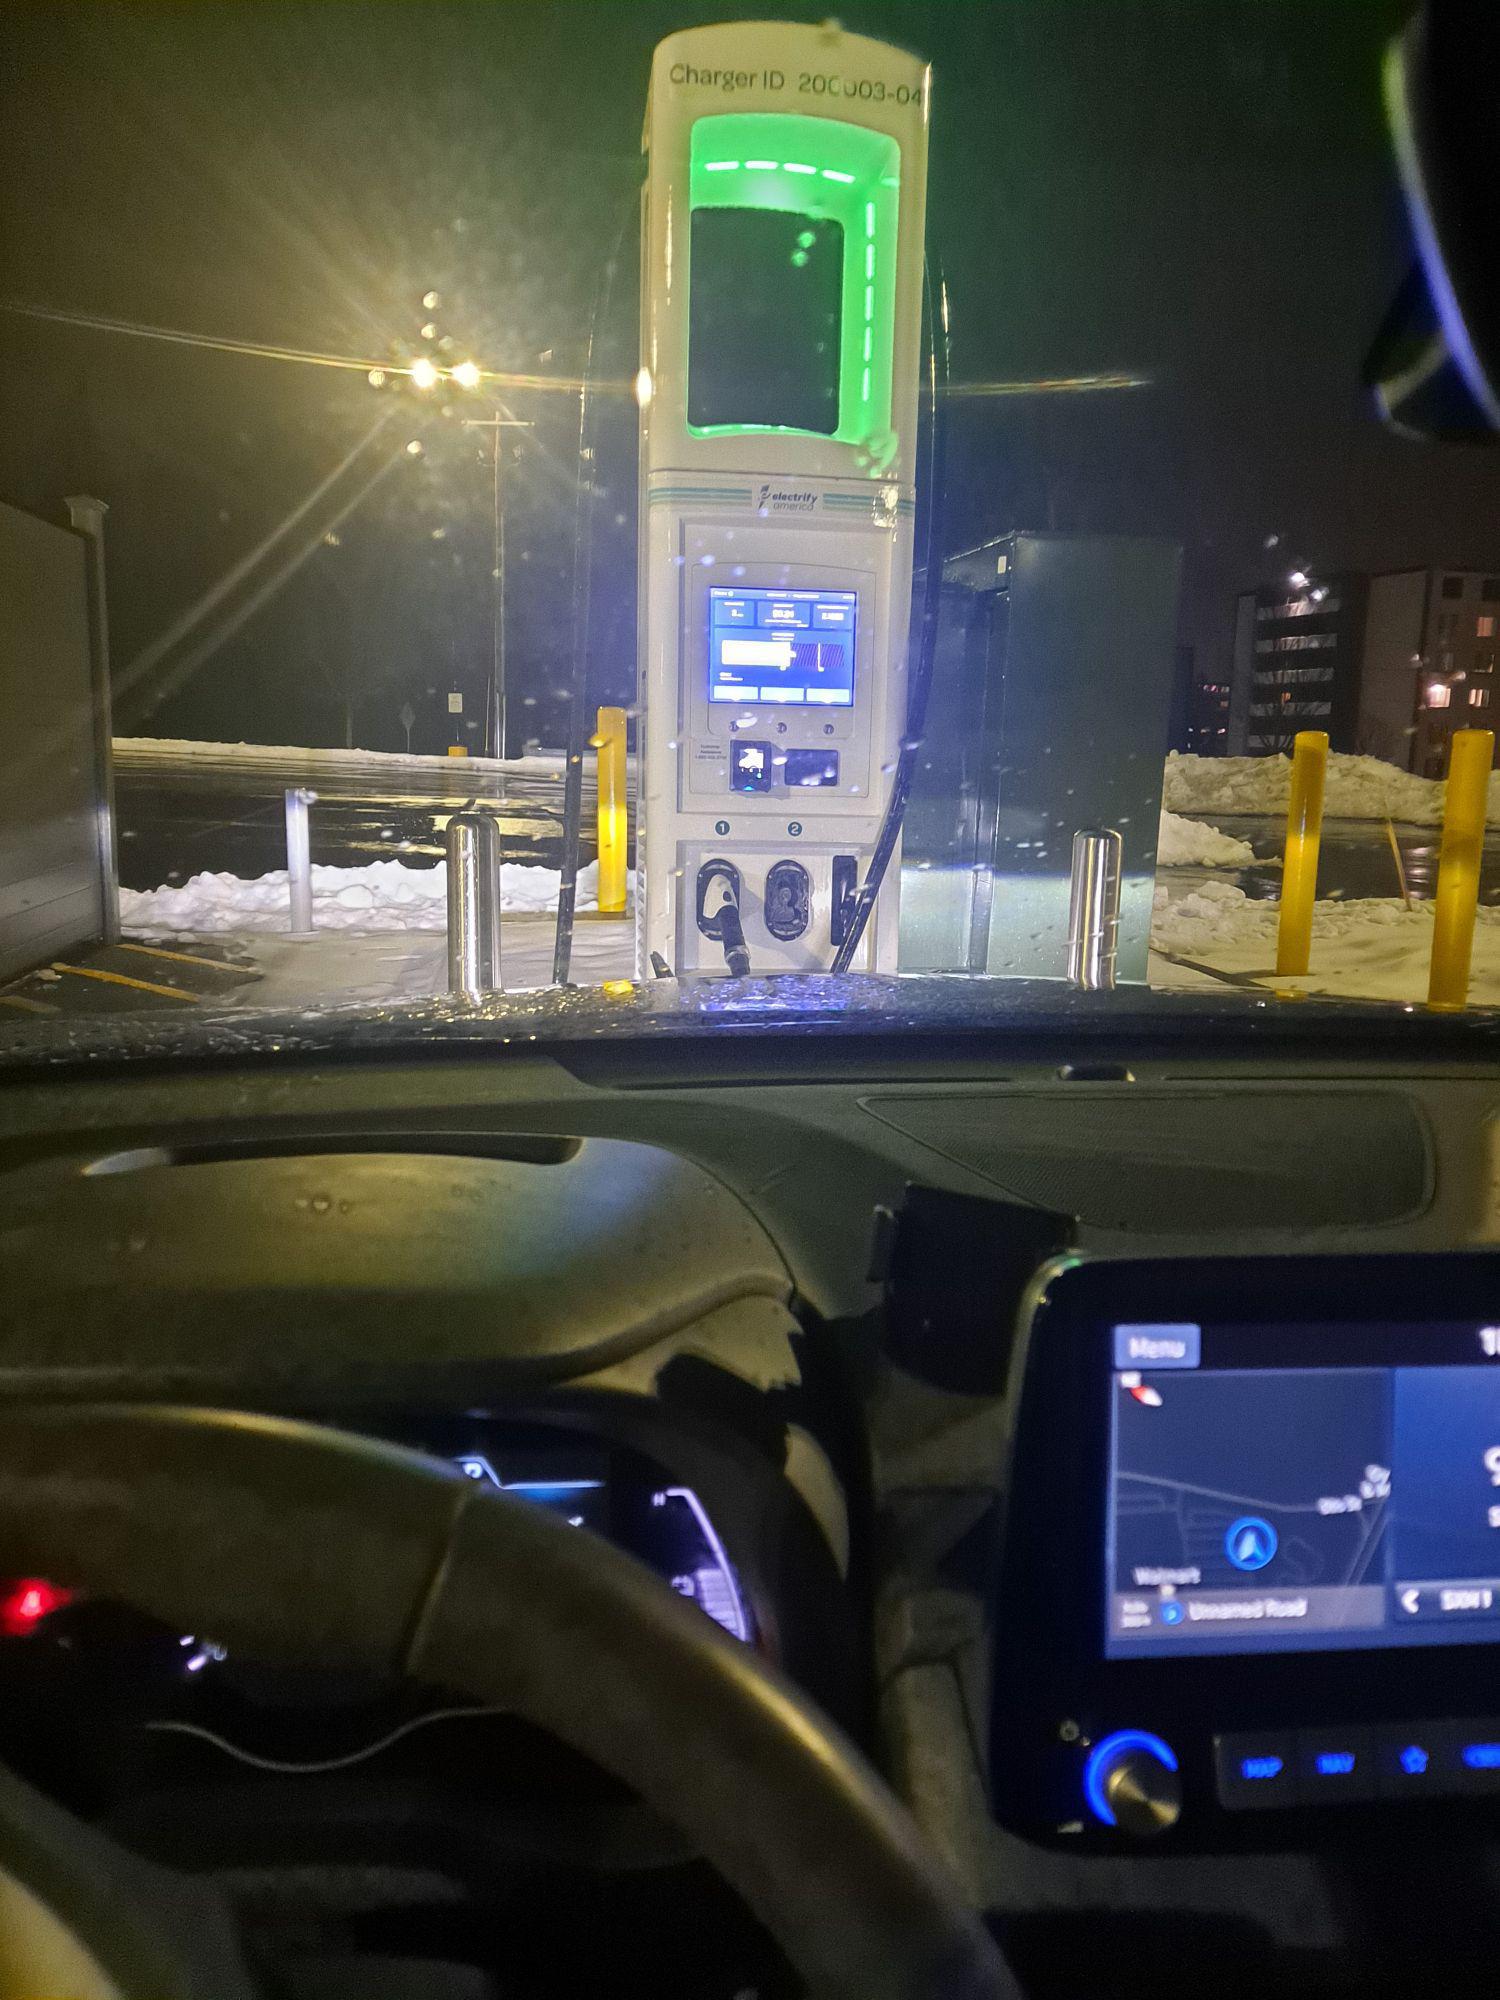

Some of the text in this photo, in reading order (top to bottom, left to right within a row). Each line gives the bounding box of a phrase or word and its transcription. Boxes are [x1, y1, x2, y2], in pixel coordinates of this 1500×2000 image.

[669, 62, 758, 92] Charger
[763, 70, 785, 90] ID
[772, 492, 818, 504] electrify
[773, 502, 814, 512] america
